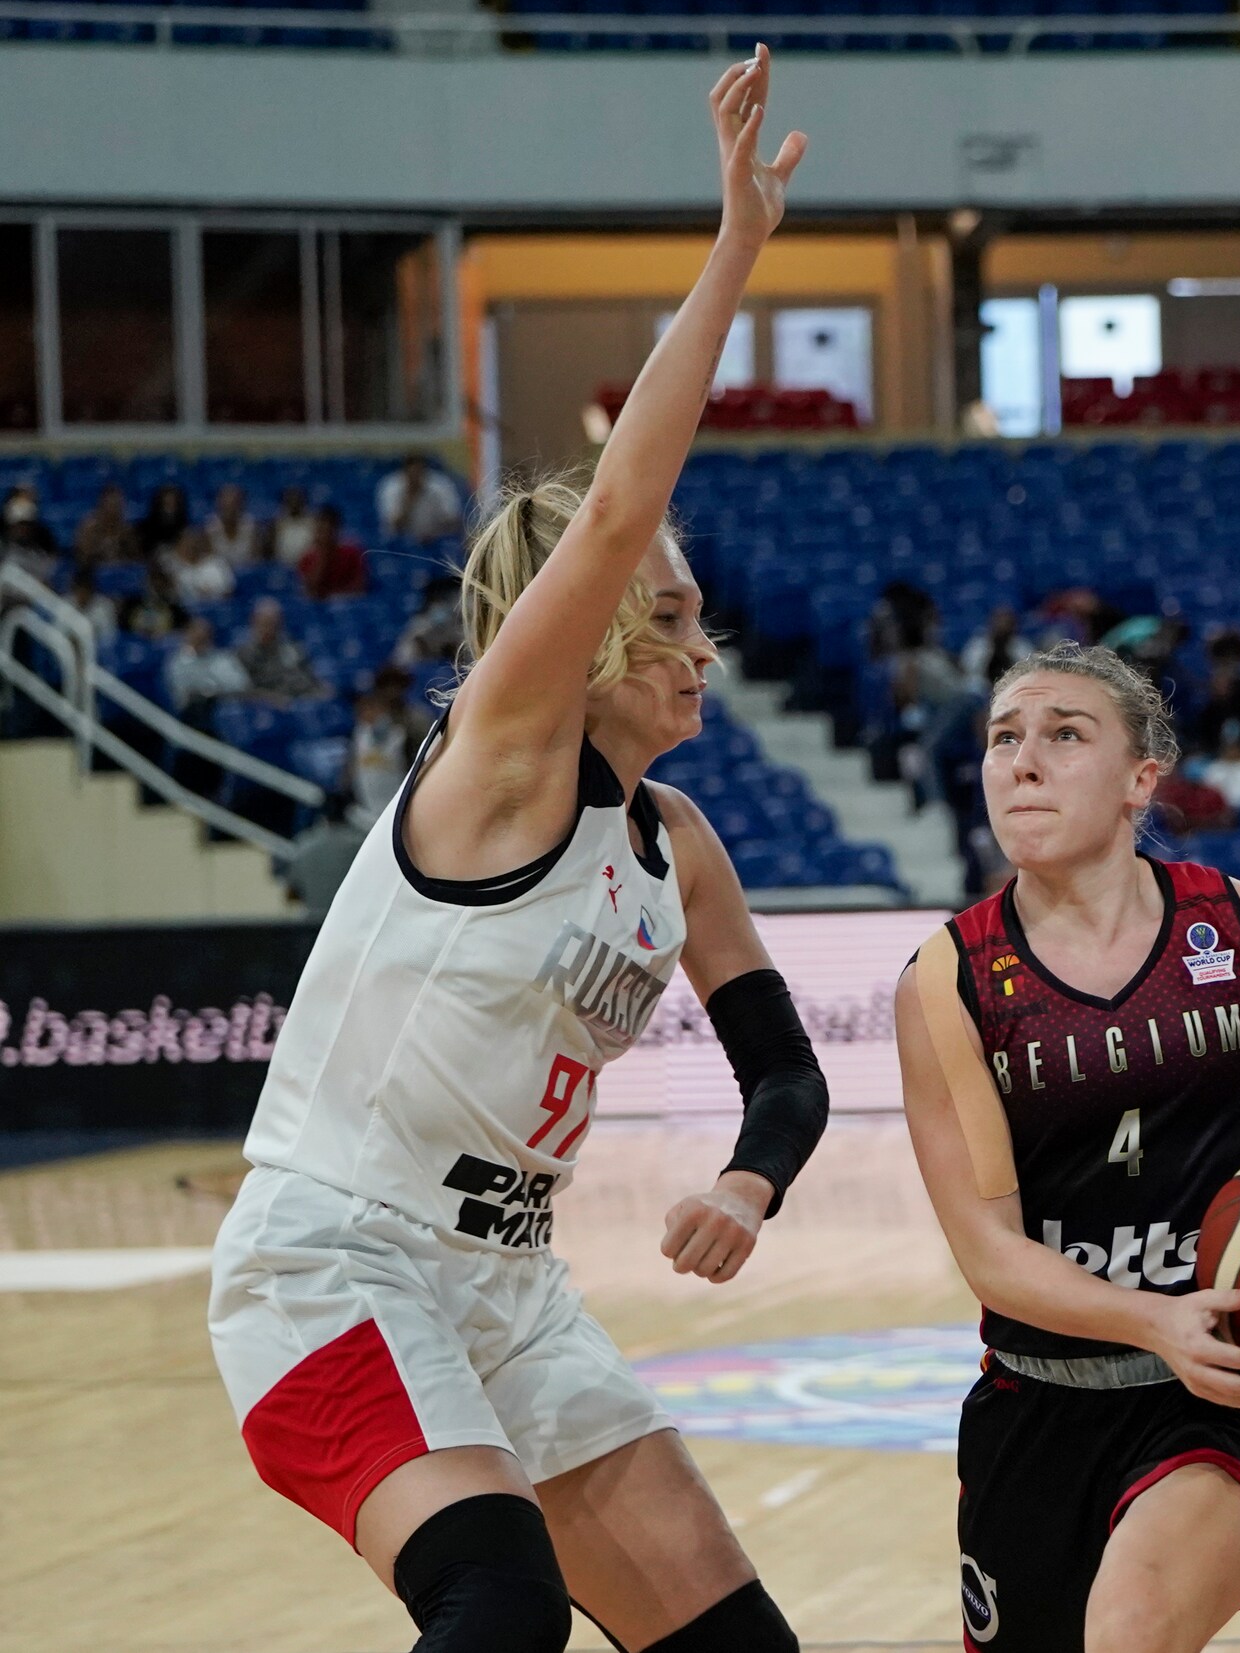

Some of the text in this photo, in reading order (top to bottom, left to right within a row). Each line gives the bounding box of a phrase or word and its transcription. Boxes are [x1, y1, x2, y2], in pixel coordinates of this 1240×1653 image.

[1188, 955, 1231, 968] WORLD CUP
[1107, 1108, 1143, 1177] 4
[462, 1155, 561, 1209] PAR
[962, 1585, 990, 1617] OLVO
